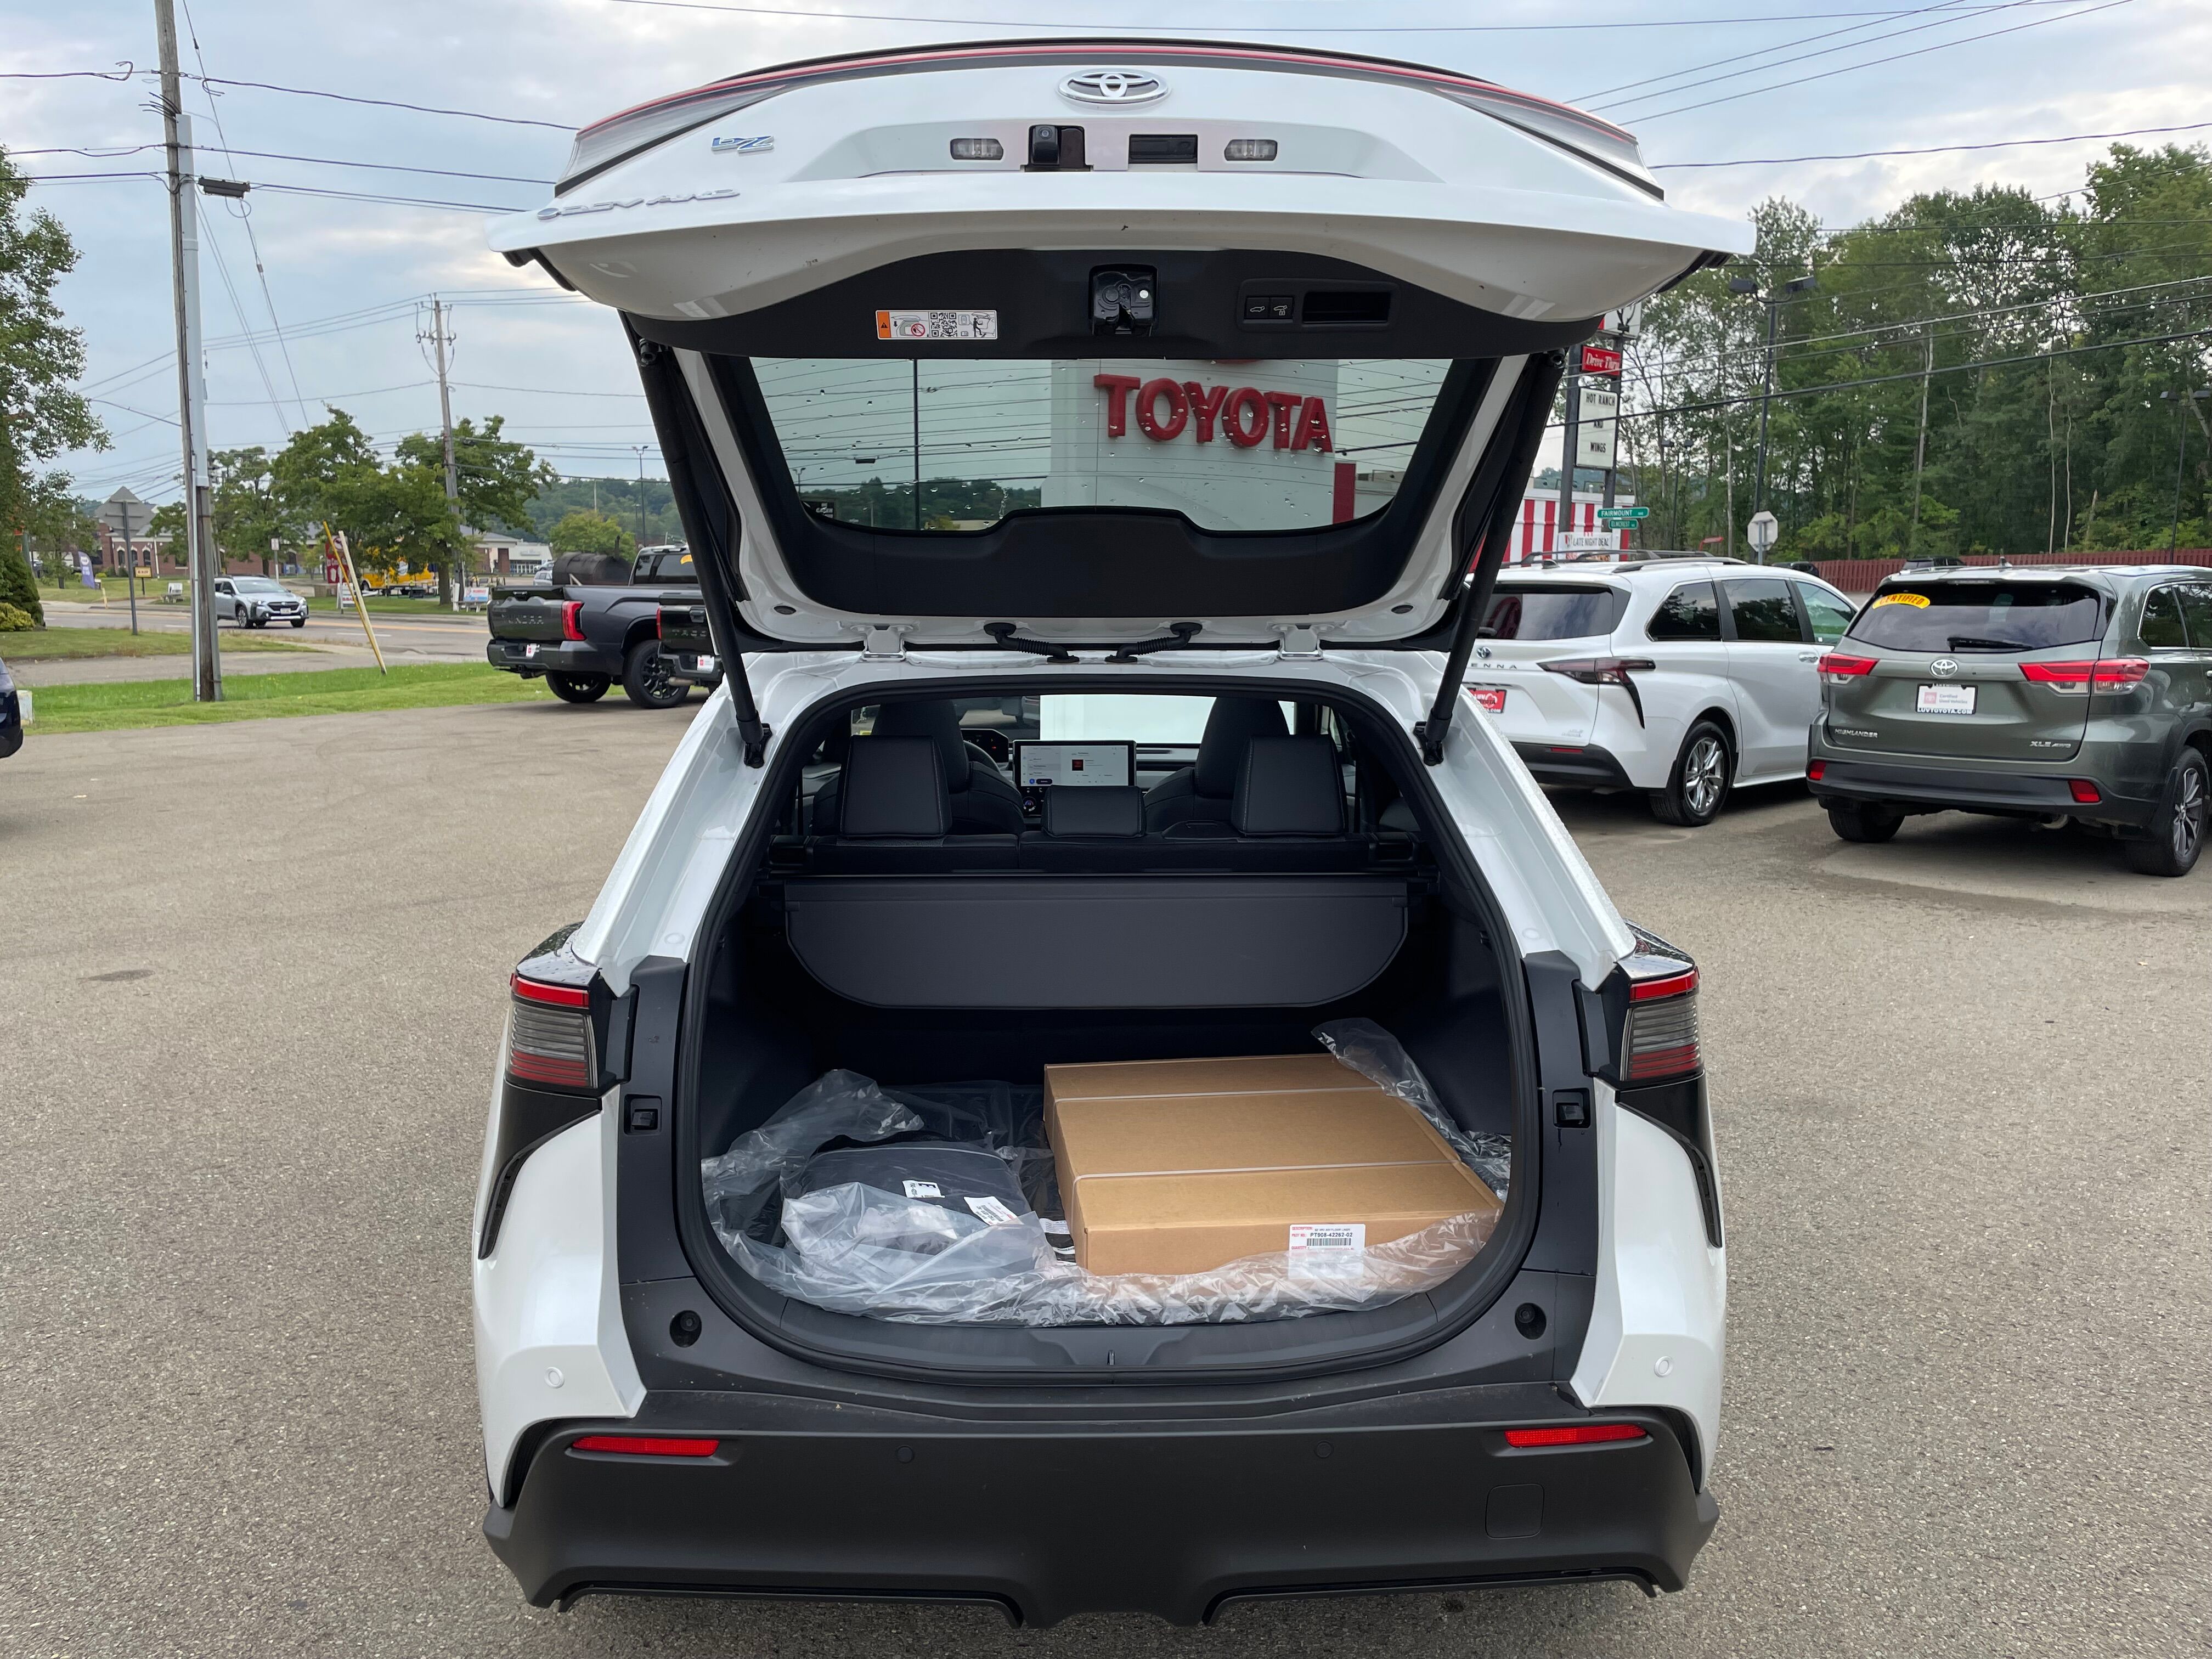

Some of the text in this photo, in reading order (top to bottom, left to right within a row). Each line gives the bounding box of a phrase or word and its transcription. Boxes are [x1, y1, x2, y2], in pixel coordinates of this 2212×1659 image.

[1586, 392, 1616, 407] HOT RANCH
[1093, 374, 1333, 453] TOYOTA
[1590, 442, 1606, 453] WINGS
[1573, 537, 1609, 546] LATE NIGHT DEAL
[1880, 594, 1925, 605] CERTIFIED
[1835, 728, 1878, 738] HIGHLANDER
